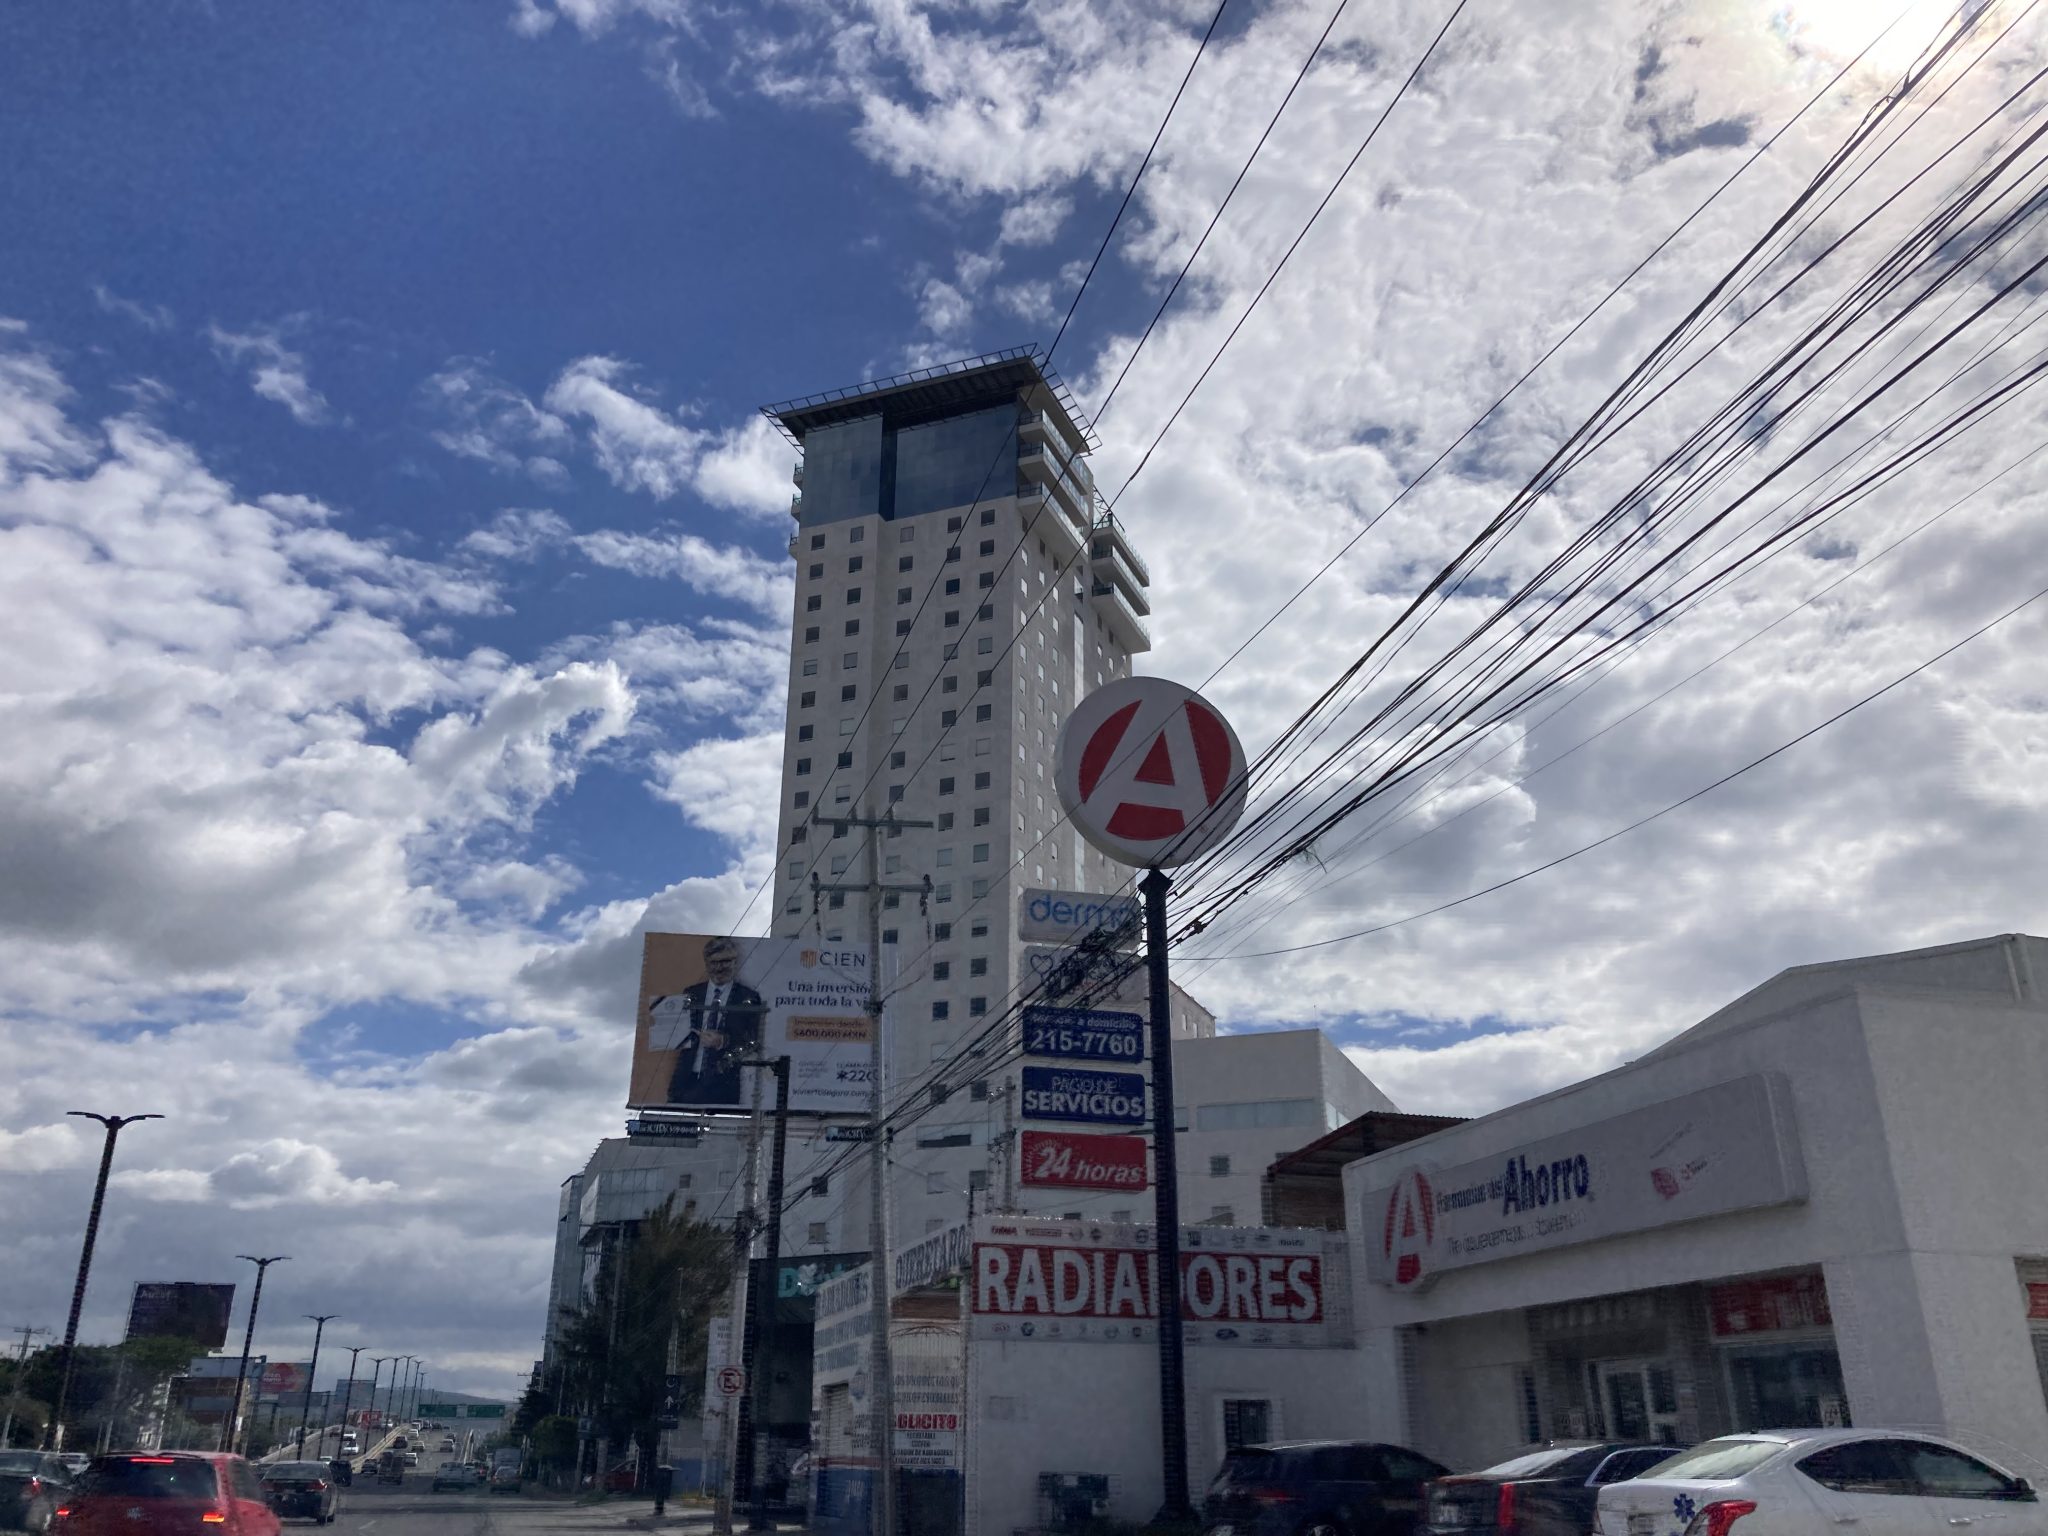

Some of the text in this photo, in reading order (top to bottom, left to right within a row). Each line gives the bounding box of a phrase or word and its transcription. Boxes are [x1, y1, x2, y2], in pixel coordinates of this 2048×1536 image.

[820, 951, 865, 967] CIEN
[788, 981, 813, 993] Una
[775, 995, 805, 1009] para
[809, 995, 838, 1008] toda
[841, 996, 852, 1008] la
[1030, 1029, 1137, 1056] 215-7760
[1052, 1075, 1093, 1094] PAGO
[1025, 1089, 1144, 1117] SERVICIOS
[1034, 1147, 1141, 1183] 24 horas
[1502, 1153, 1590, 1217] Ahorro
[895, 1413, 958, 1431] OLICITO
